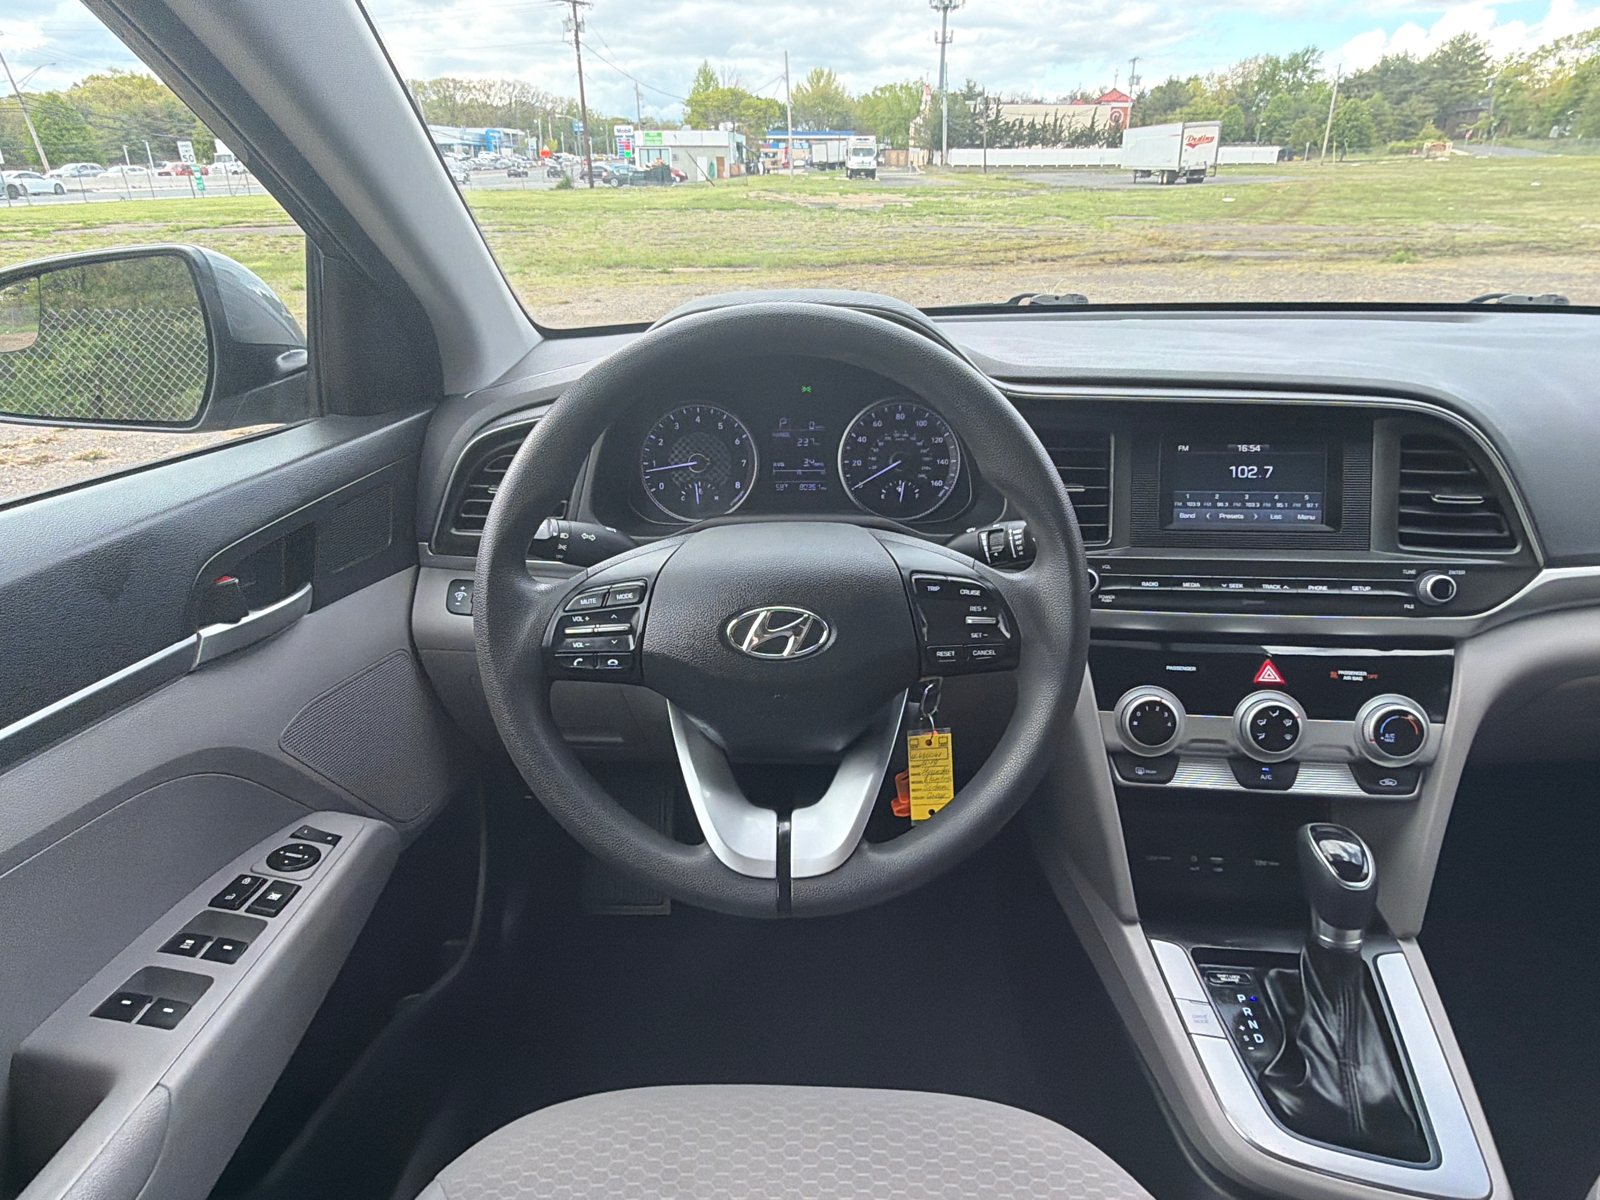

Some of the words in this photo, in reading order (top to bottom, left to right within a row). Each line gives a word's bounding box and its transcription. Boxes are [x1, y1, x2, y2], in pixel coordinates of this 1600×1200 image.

[182, 154, 195, 163] 50
[695, 415, 701, 423] 4
[674, 422, 680, 430] 3
[718, 422, 724, 430] 5
[658, 438, 664, 446] 2
[652, 460, 656, 468] 1
[1229, 466, 1274, 479] 102.7
[658, 482, 665, 490] 0
[735, 481, 741, 489] 8
[1237, 994, 1246, 1003] P
[1242, 1007, 1253, 1016] R
[1248, 1020, 1259, 1029] N
[1253, 1034, 1264, 1043] D
